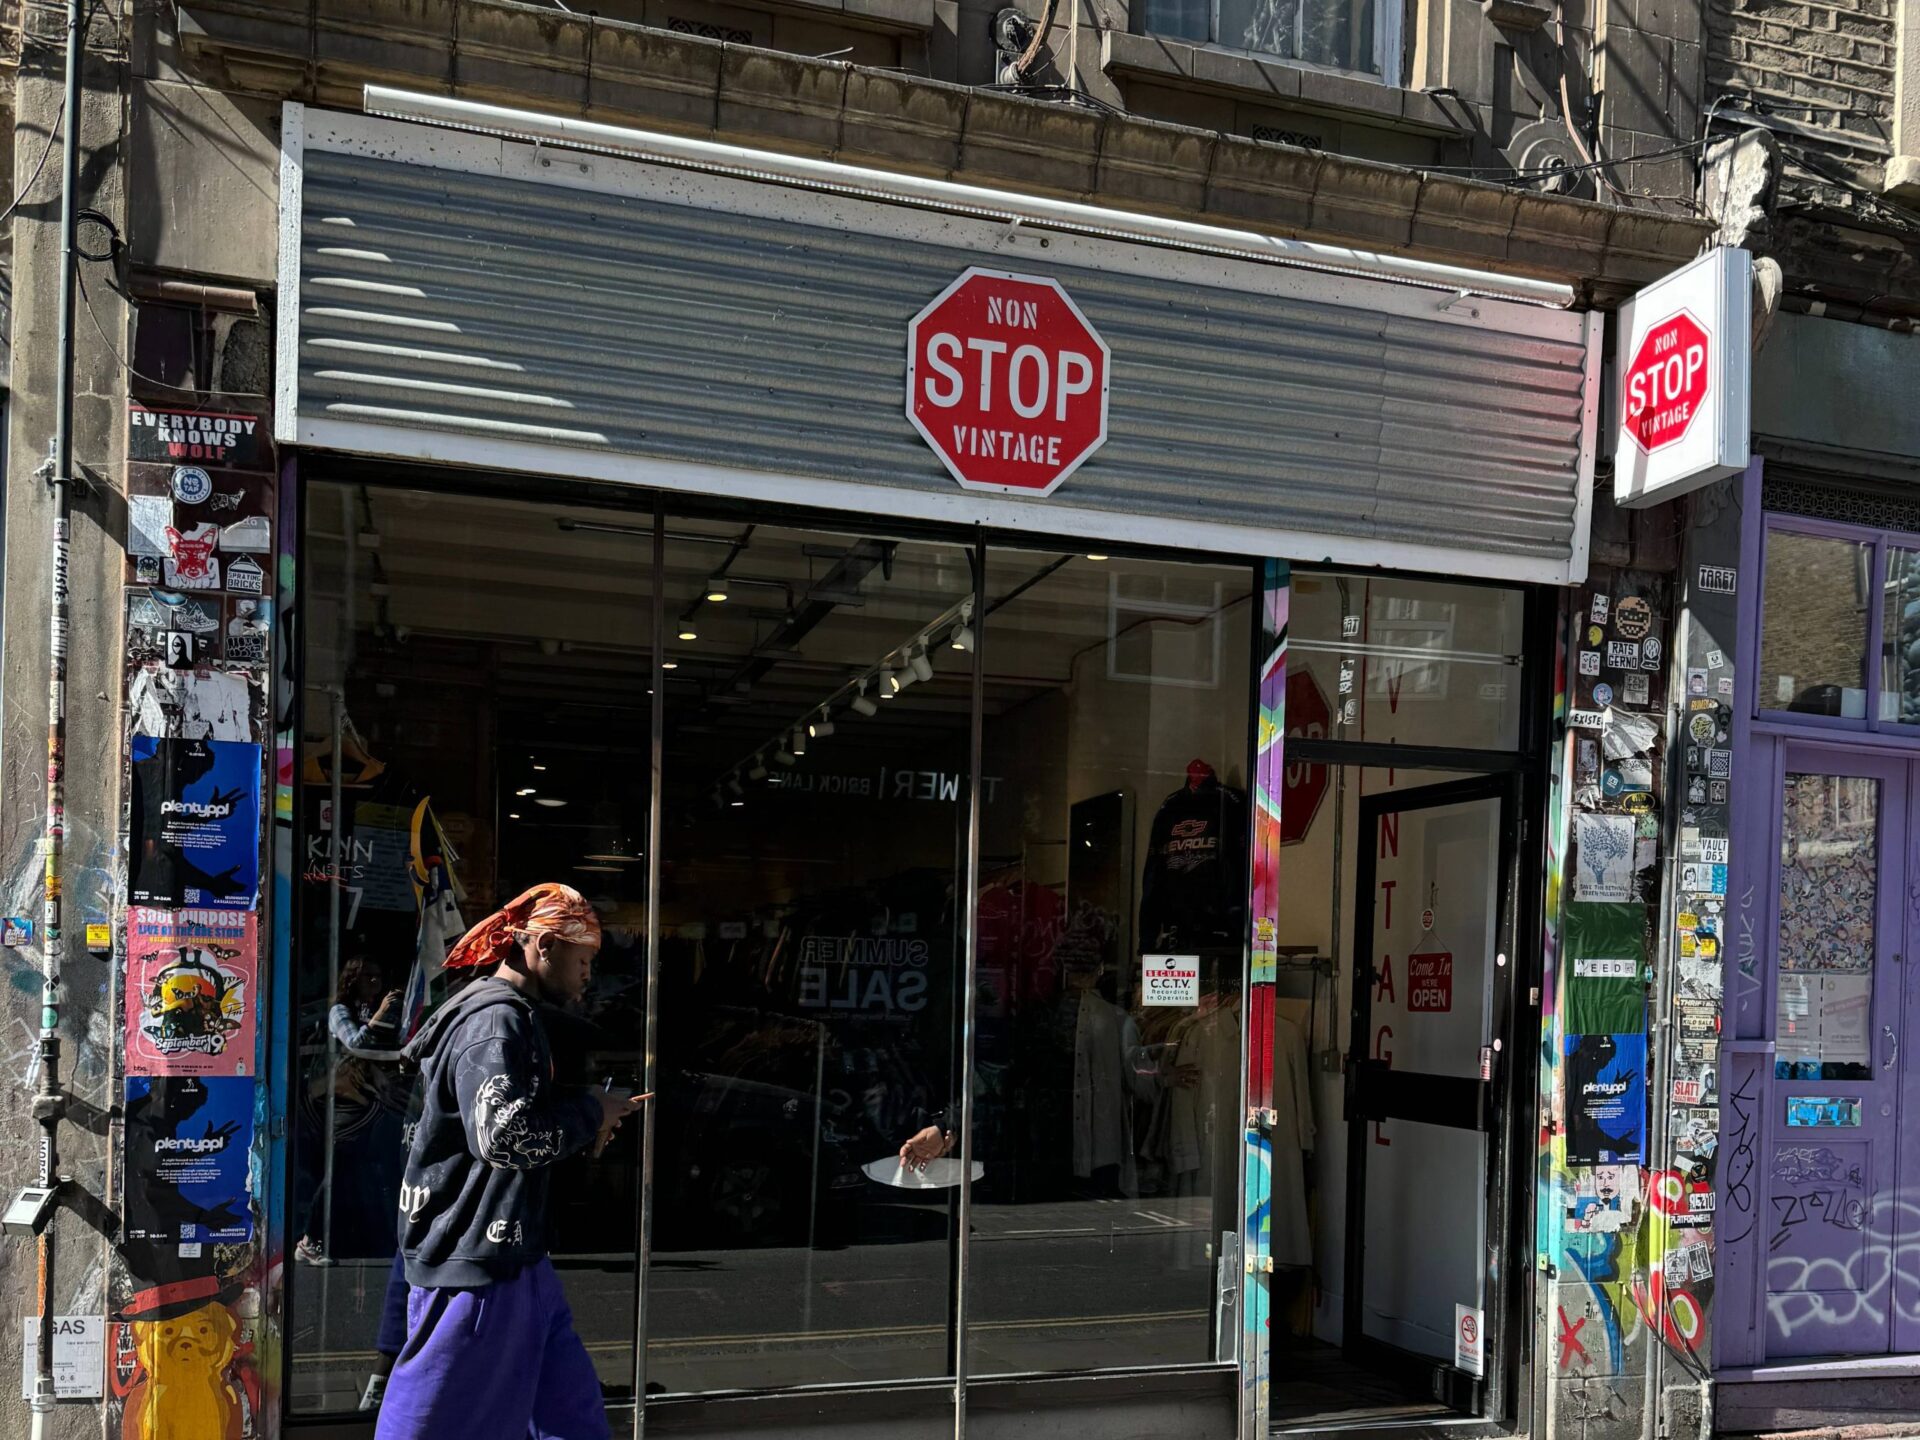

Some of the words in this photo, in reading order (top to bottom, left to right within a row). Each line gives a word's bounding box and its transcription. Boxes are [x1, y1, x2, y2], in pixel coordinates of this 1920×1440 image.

[987, 296, 1038, 331] NON
[1654, 328, 1678, 355] NON
[924, 332, 1094, 422] STOP
[1629, 344, 1704, 417] STOP
[131, 411, 256, 435] EVERYBODY
[1641, 401, 1691, 438] VINTAGE
[157, 428, 237, 447] KNOWS
[953, 425, 1062, 467] VINTAGE
[168, 442, 227, 460] WOLF
[227, 579, 261, 589] BRICKS
[1612, 642, 1634, 655] RATS
[160, 800, 229, 818] plentyppl
[1702, 839, 1727, 851] VAULT
[137, 908, 173, 923] SOUL
[178, 910, 246, 927] PURPOSE
[138, 925, 159, 935] LIVE
[1146, 970, 1195, 978] SECURITY
[1410, 959, 1434, 976] Come
[1438, 957, 1451, 976] In
[1150, 978, 1191, 989] C.C.T.V.
[1412, 989, 1447, 1008] OPEN
[154, 1033, 207, 1054] September
[207, 1034, 224, 1054] 19
[1583, 1082, 1627, 1095] plentyppl
[1675, 1081, 1700, 1097] SLATT
[154, 1136, 224, 1153] plentyppl
